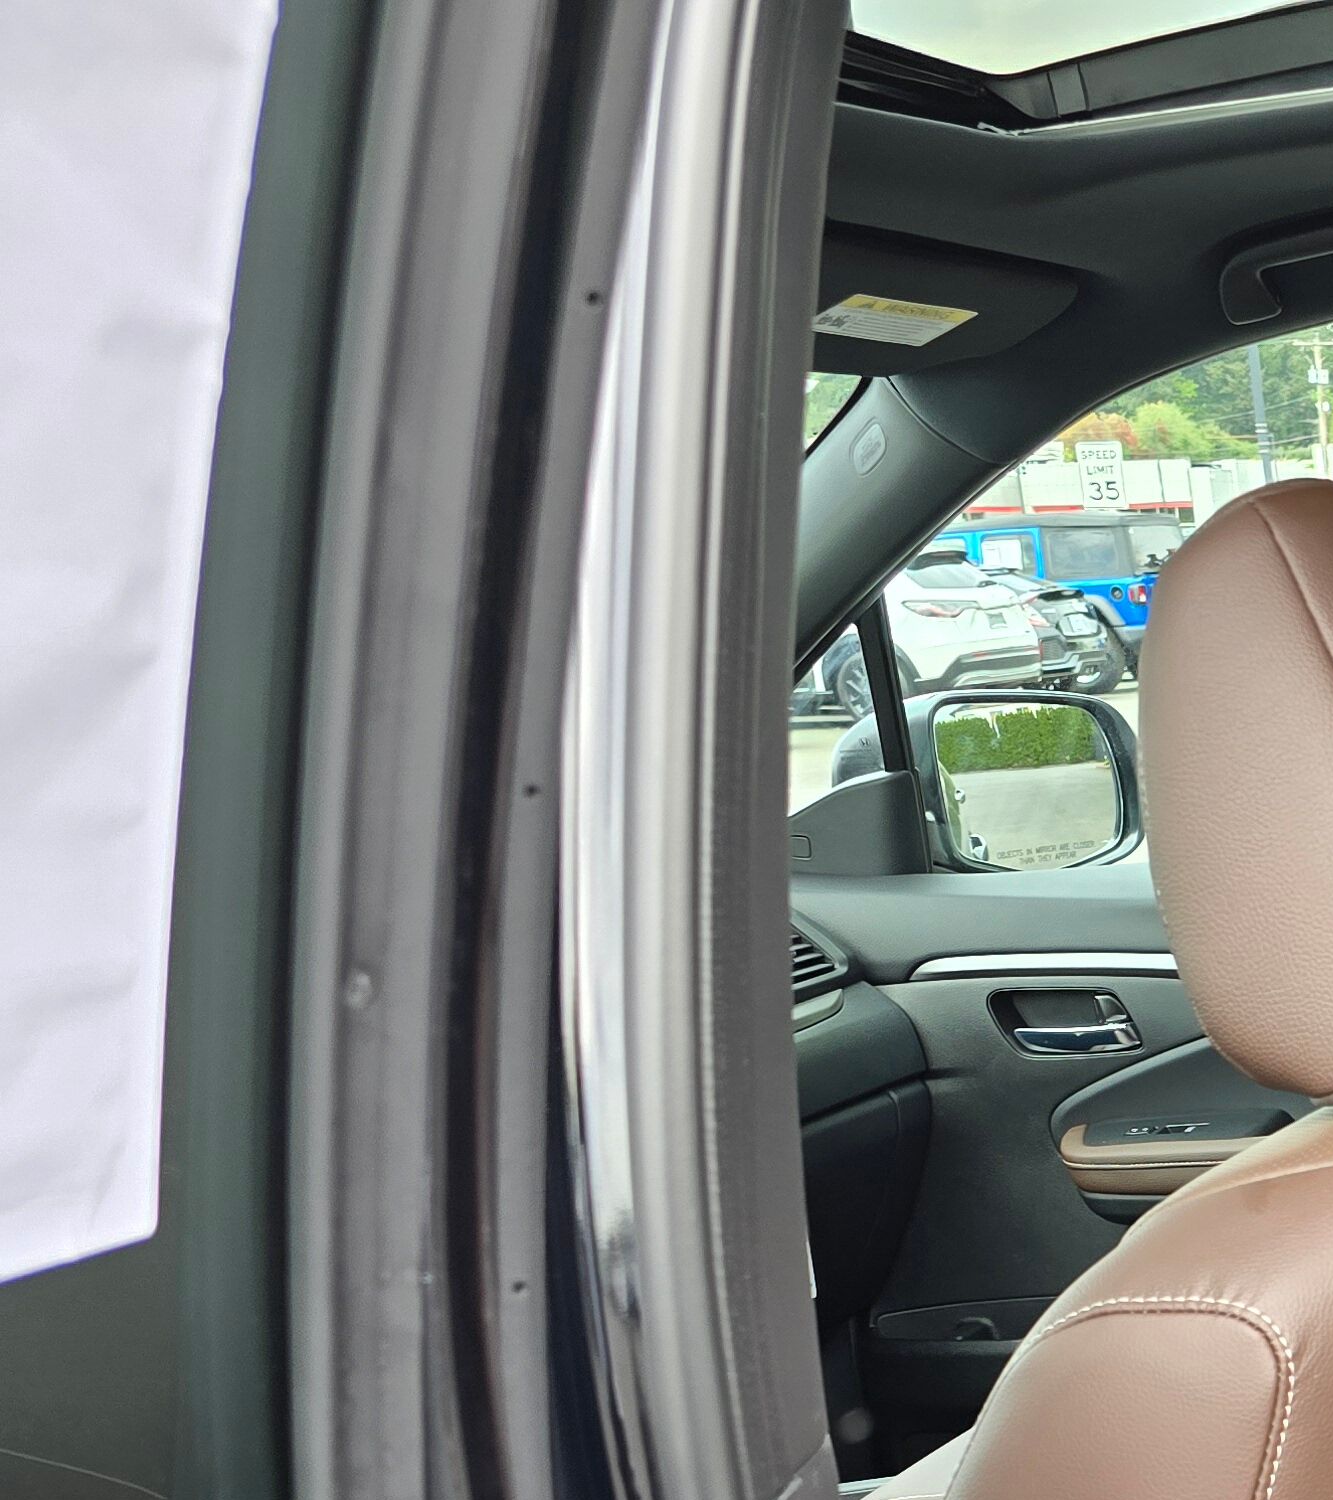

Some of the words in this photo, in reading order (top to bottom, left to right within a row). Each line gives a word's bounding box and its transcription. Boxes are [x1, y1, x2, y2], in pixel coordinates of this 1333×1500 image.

[1081, 450, 1117, 460] SPEED
[1086, 465, 1114, 475] LIMIT
[1089, 481, 1120, 501] 35
